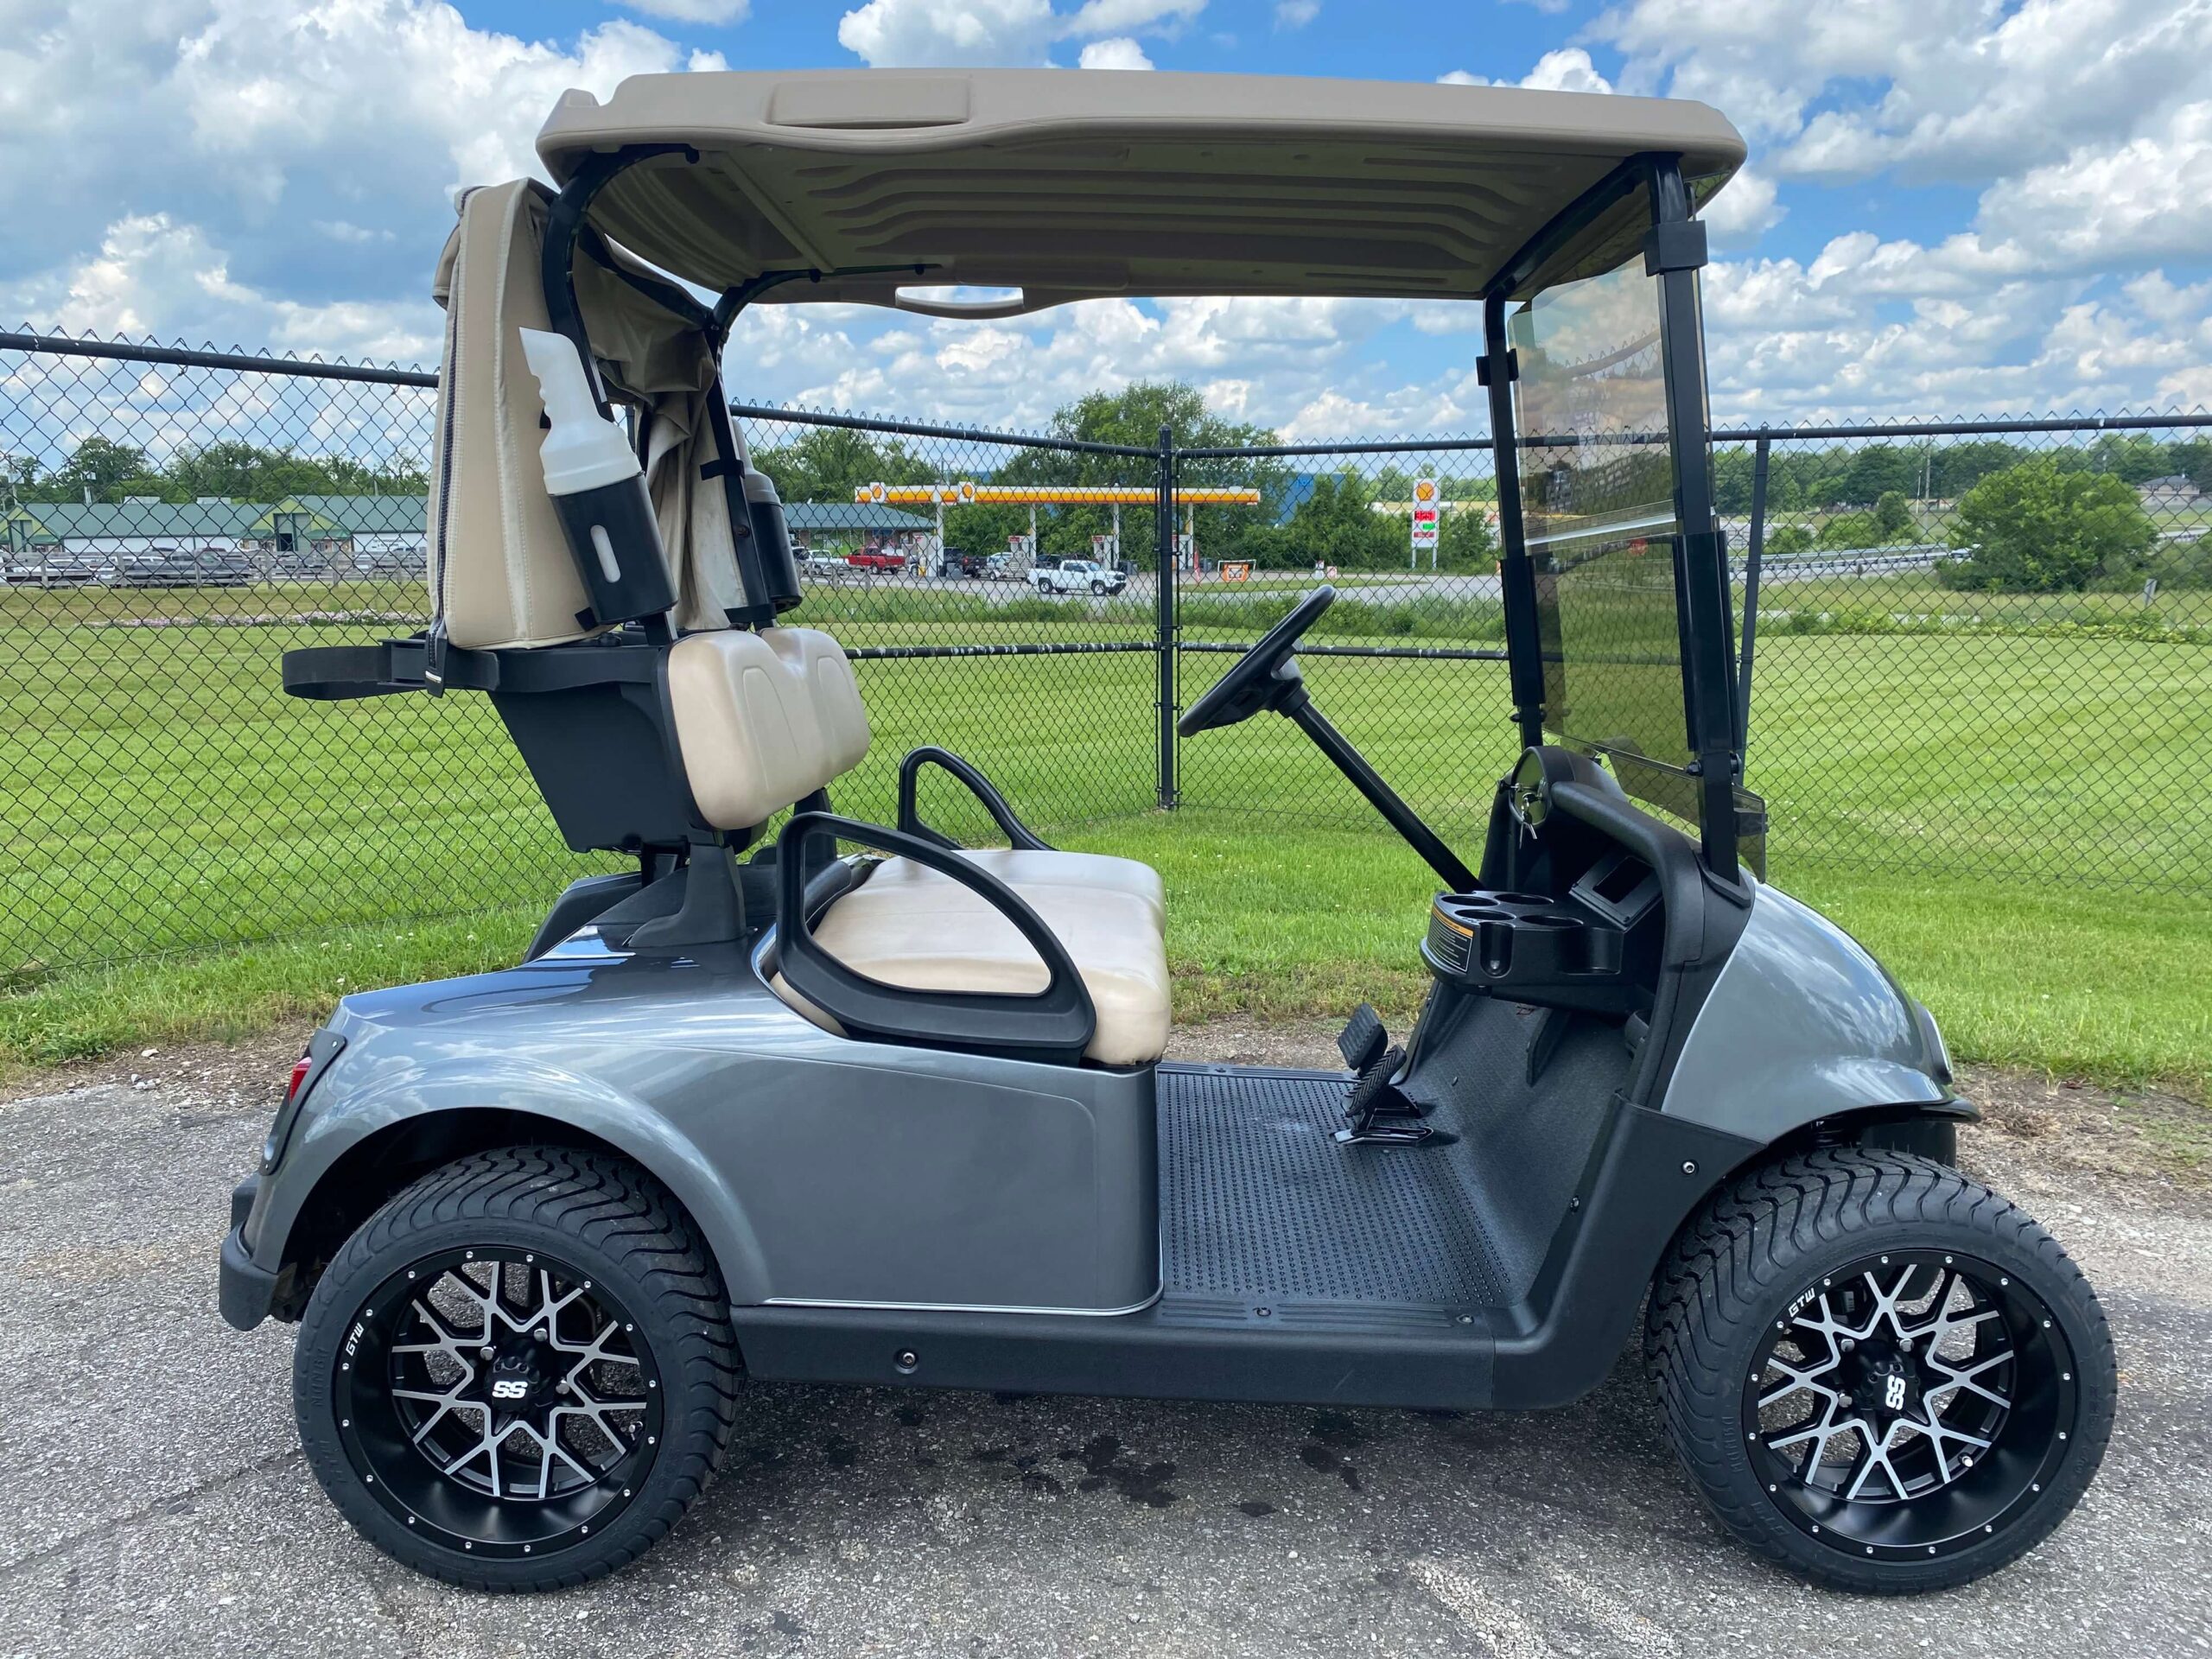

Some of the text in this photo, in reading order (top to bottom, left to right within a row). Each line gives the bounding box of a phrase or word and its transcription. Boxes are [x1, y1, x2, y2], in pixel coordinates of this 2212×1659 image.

[1788, 1287, 1816, 1318] GTW
[346, 1322, 365, 1357] GTW
[492, 1381, 528, 1399] SS
[1885, 1374, 1906, 1411] SS
